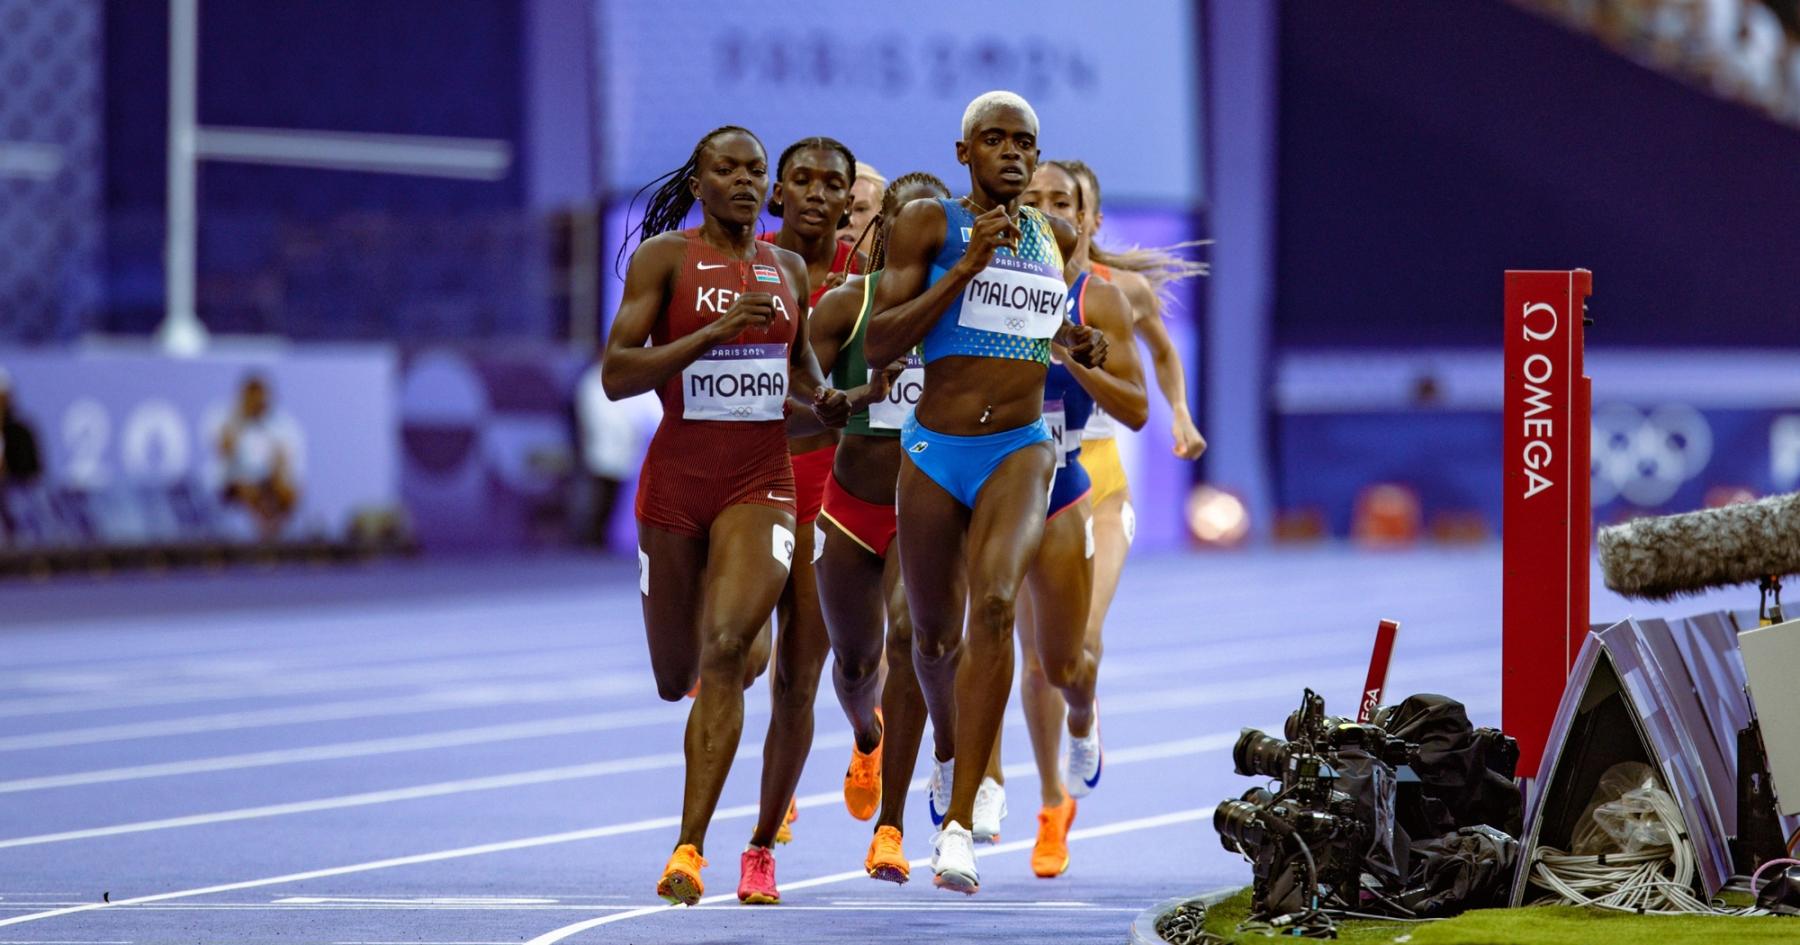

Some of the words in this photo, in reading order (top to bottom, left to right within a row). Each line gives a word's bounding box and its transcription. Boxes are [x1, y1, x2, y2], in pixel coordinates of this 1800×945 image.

[995, 258, 1021, 268] PARIS
[1023, 262, 1043, 272] 2024
[695, 287, 790, 320] KEA
[968, 279, 1063, 315] MALONEY
[712, 349, 740, 357] PARIS
[743, 348, 765, 356] 2024
[691, 372, 784, 397] MORAA
[1523, 354, 1554, 500] OMEGA
[1360, 688, 1380, 721] EGA
